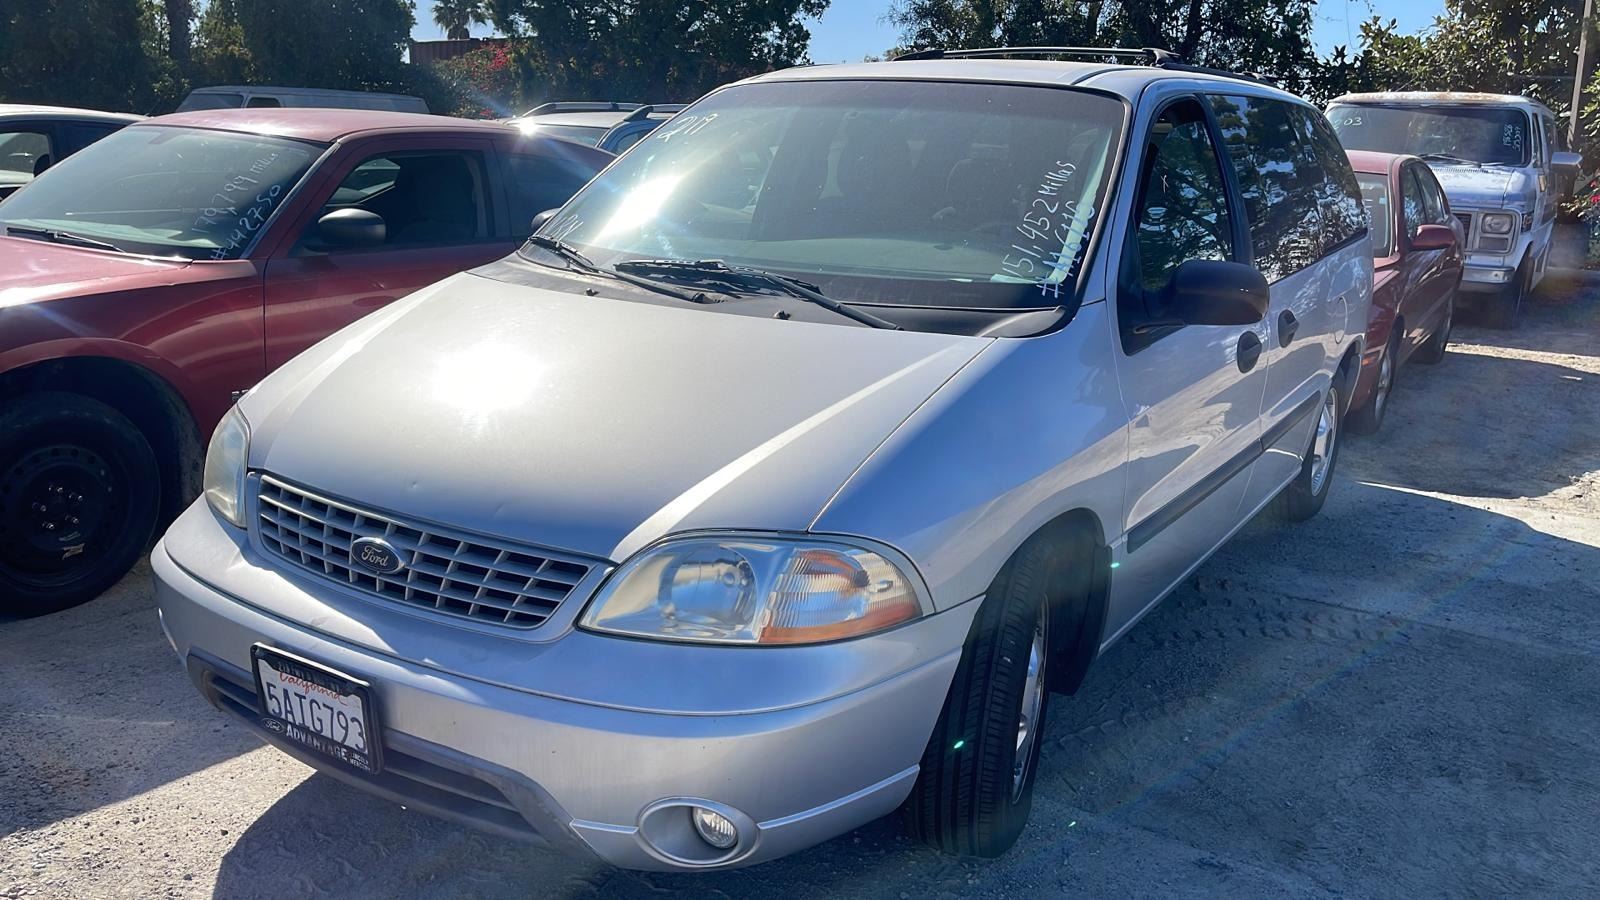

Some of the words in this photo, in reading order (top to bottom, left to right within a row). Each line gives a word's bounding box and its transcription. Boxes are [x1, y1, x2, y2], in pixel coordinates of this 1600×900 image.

[1002, 198, 1059, 276] 151,452
[361, 545, 389, 567] Ford
[266, 681, 367, 753] 5ATG793
